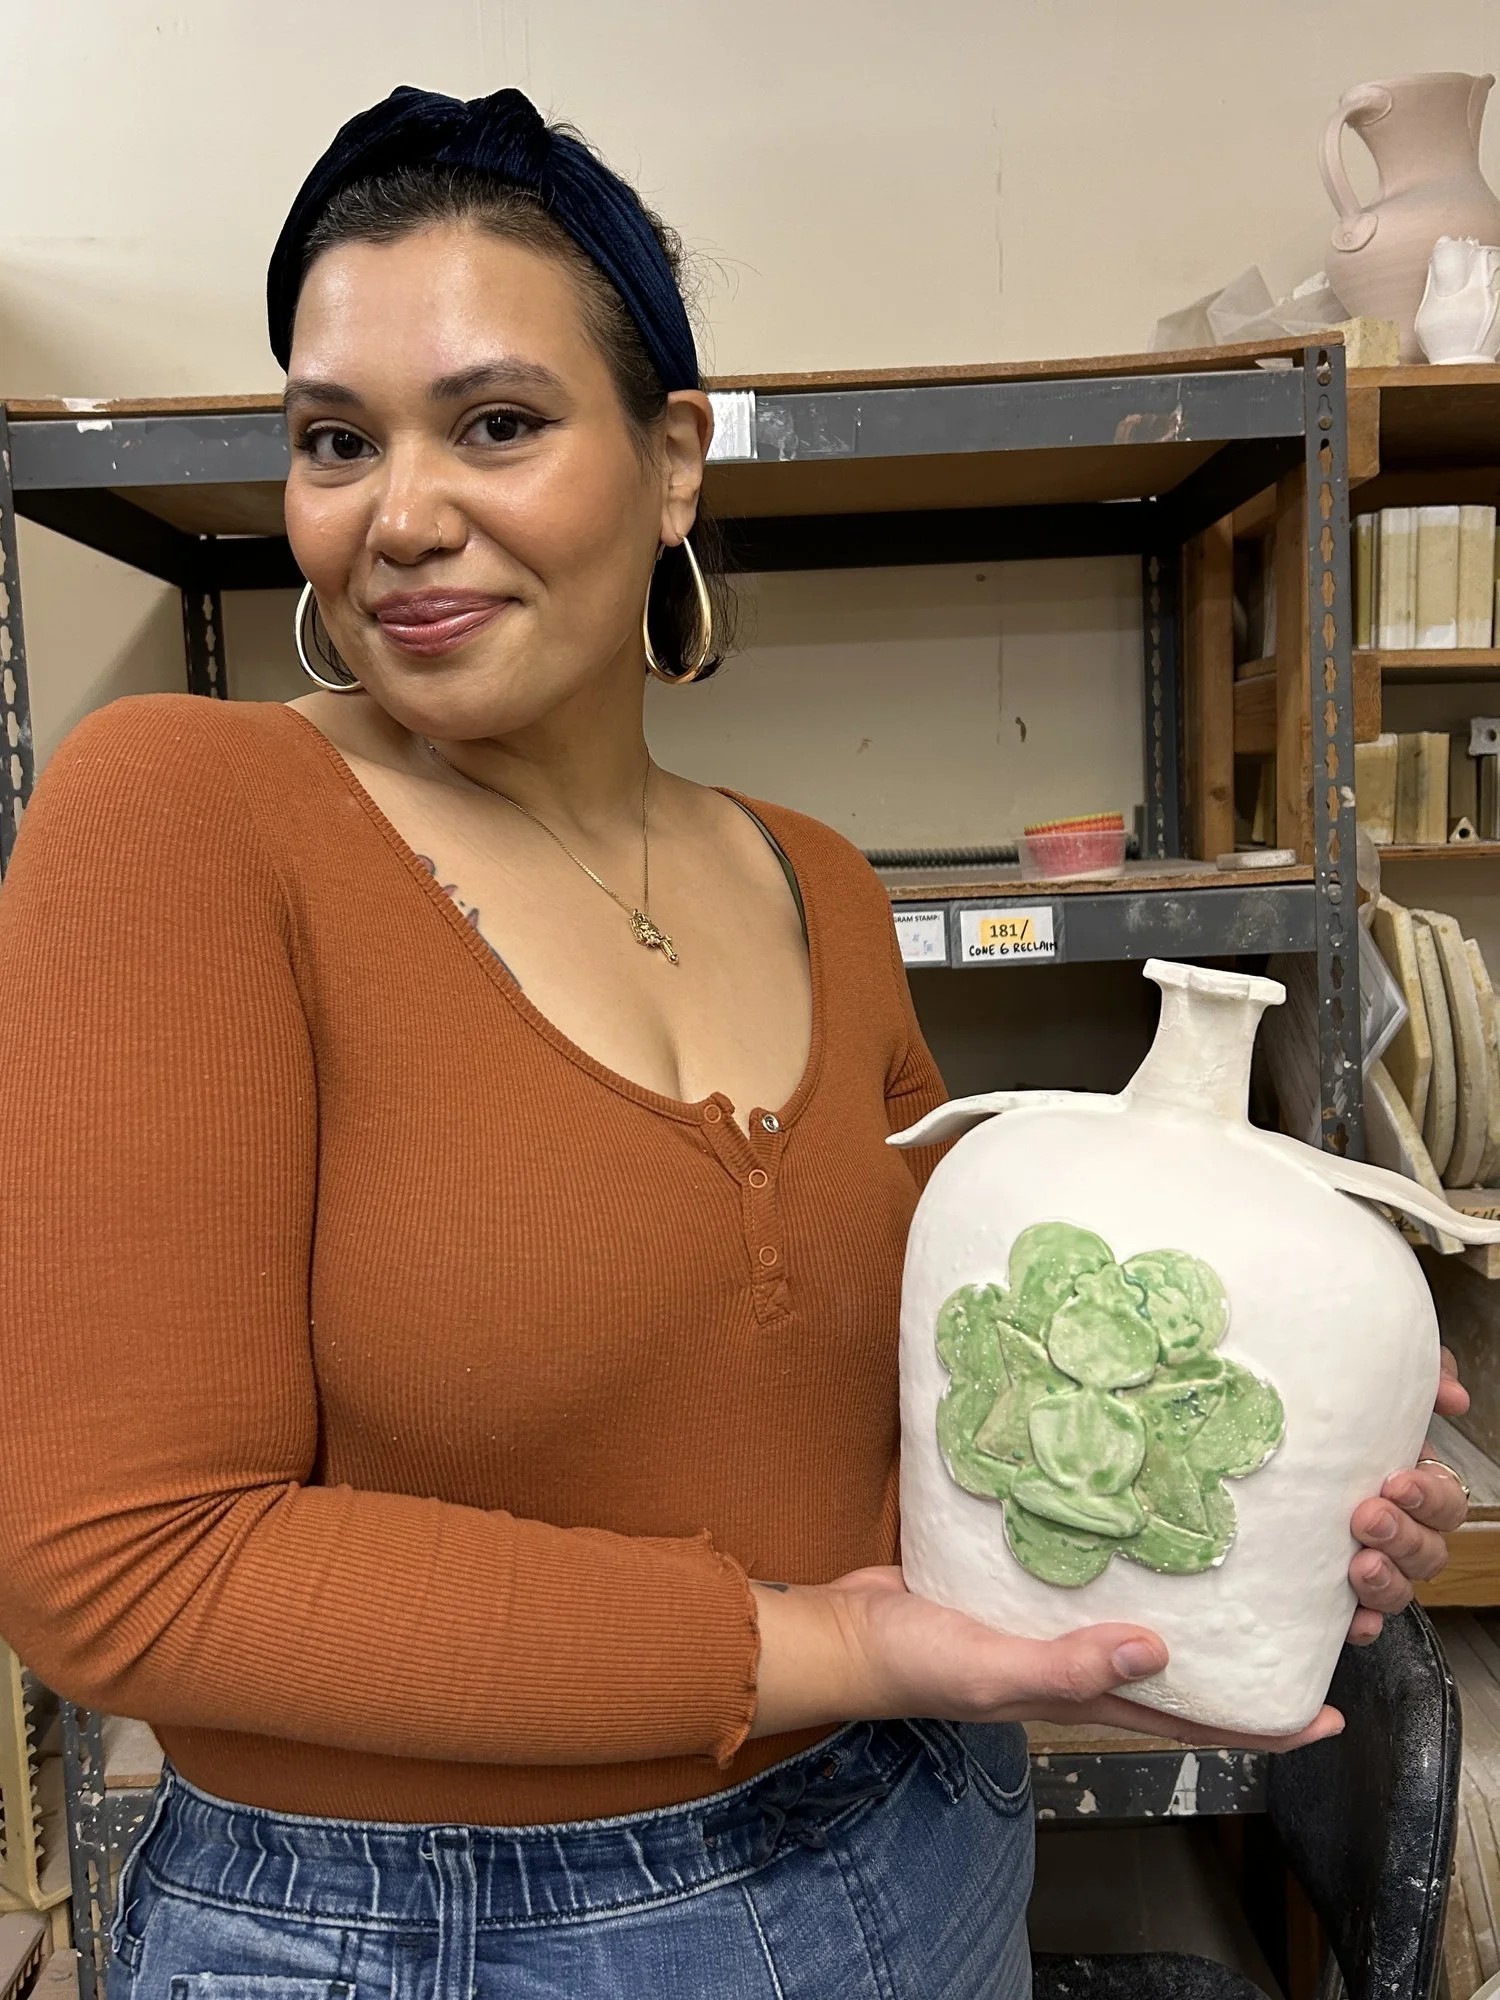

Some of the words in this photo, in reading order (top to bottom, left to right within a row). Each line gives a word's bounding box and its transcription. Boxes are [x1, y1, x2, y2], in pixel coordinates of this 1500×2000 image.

[990, 919, 1029, 941] 181/
[1000, 943, 1009, 955] 6
[1013, 940, 1058, 953] RECLAIM
